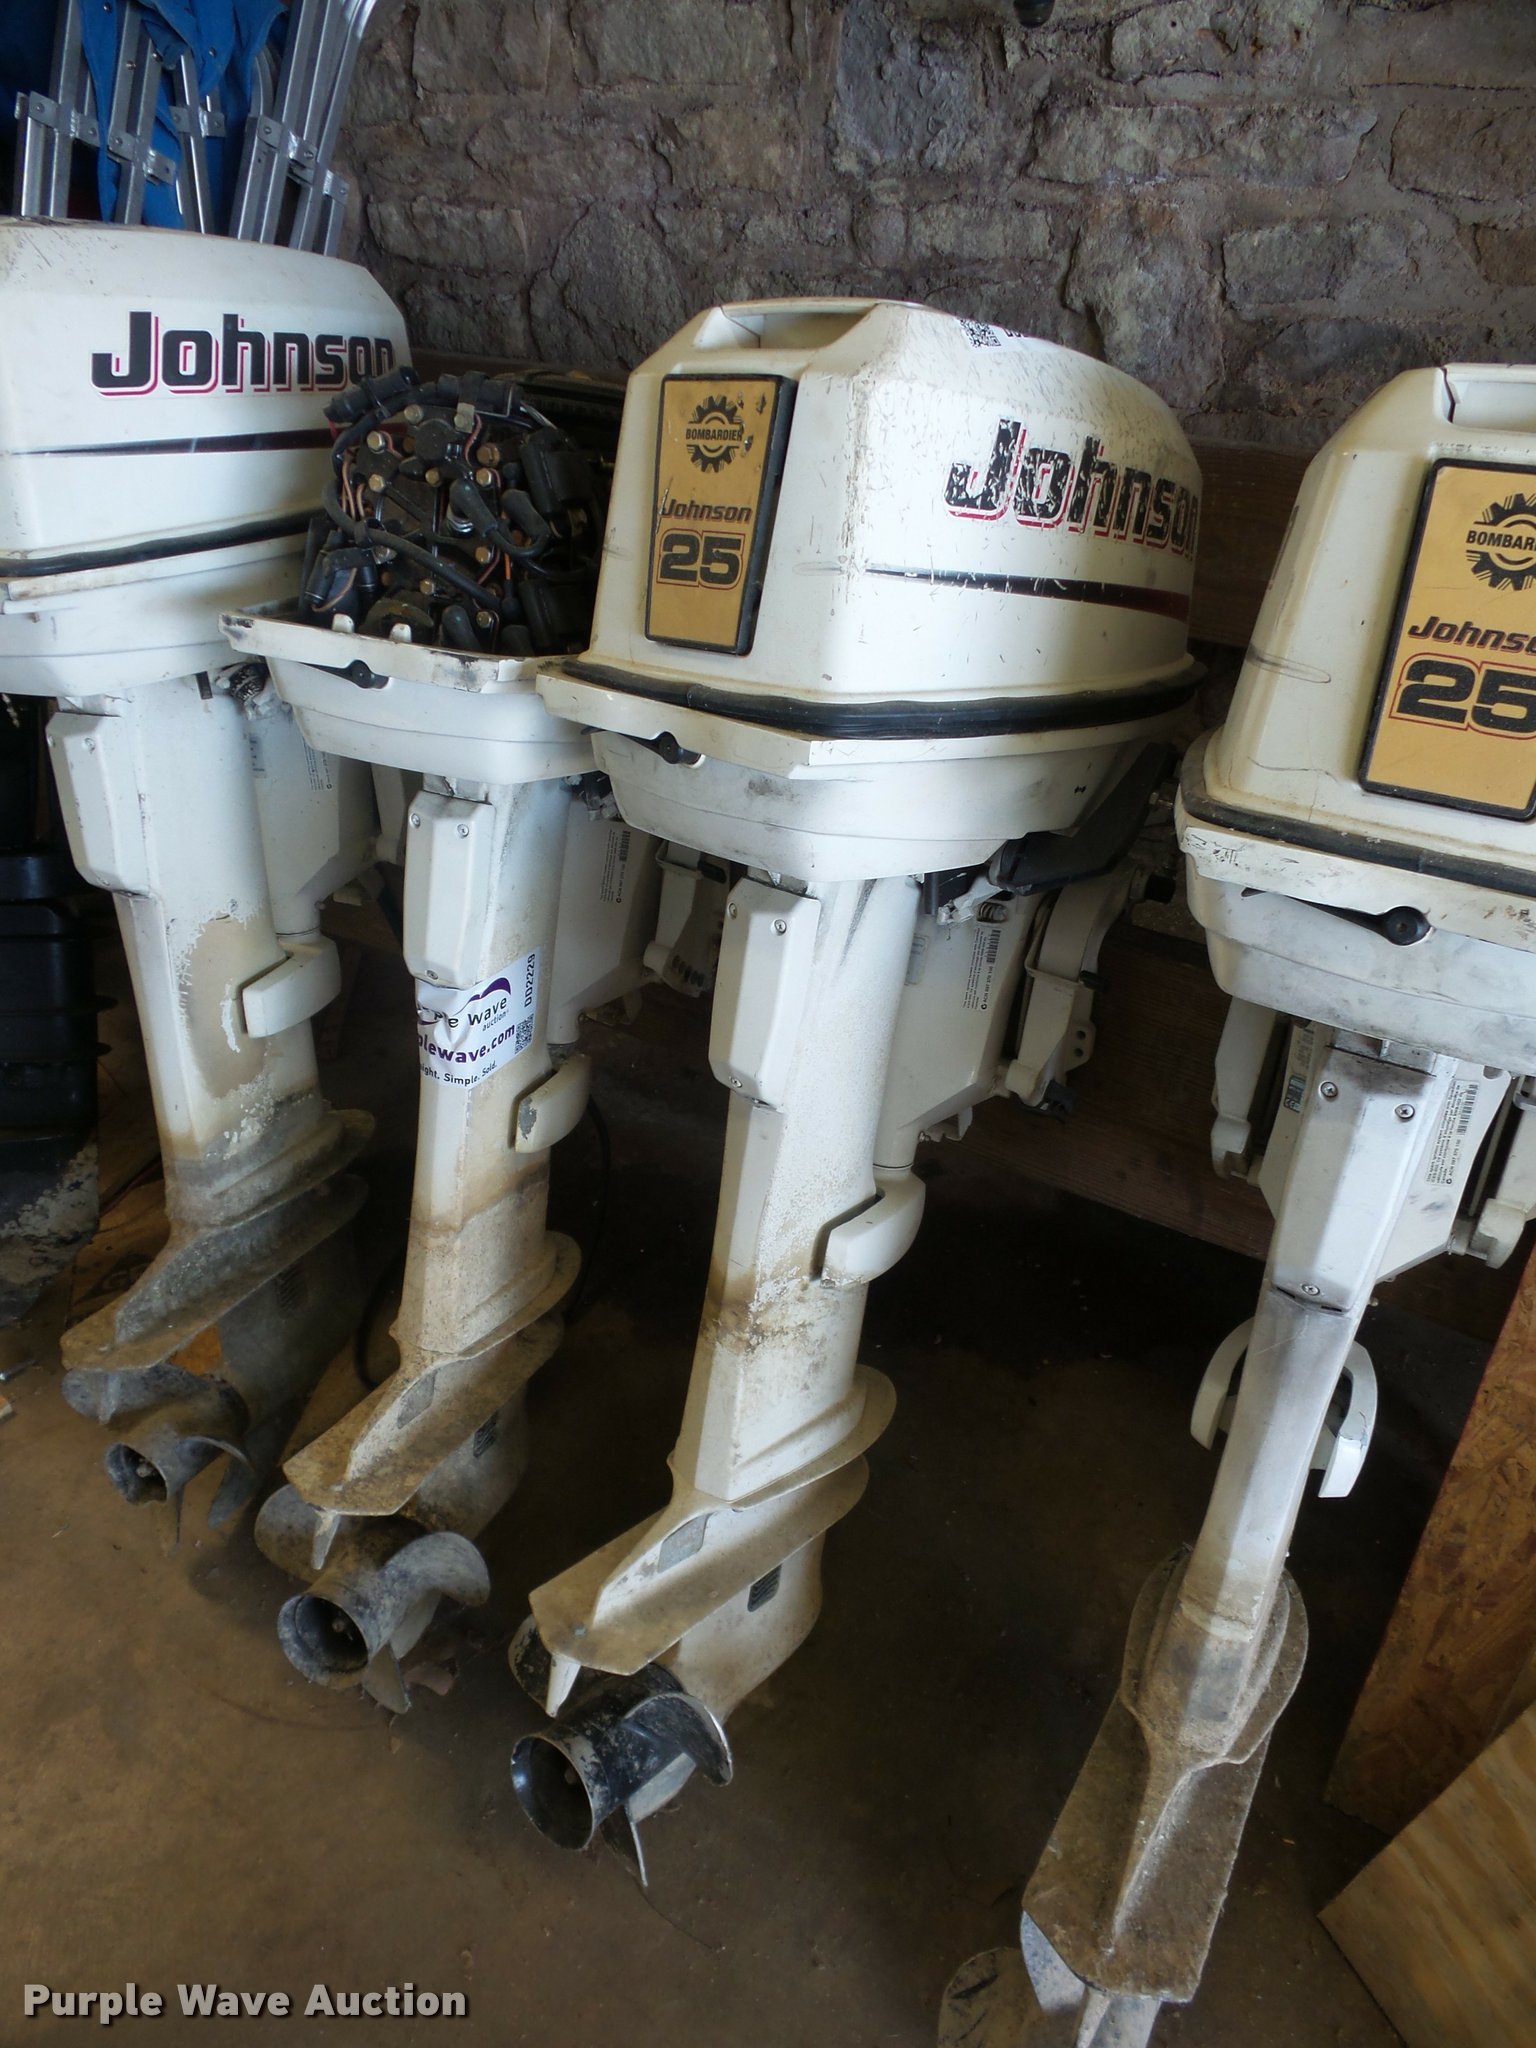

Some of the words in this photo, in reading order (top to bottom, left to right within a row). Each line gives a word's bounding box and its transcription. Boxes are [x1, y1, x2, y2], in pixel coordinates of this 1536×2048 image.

[91, 311, 396, 396] Johnson
[686, 428, 743, 442] BOMBARDIER
[945, 418, 1198, 560] Johnson
[661, 498, 752, 525] Johnson
[656, 528, 746, 590] 25
[1466, 530, 1536, 551] BOMBAR
[1389, 652, 1536, 740] 25
[443, 1072, 480, 1087] Simple.
